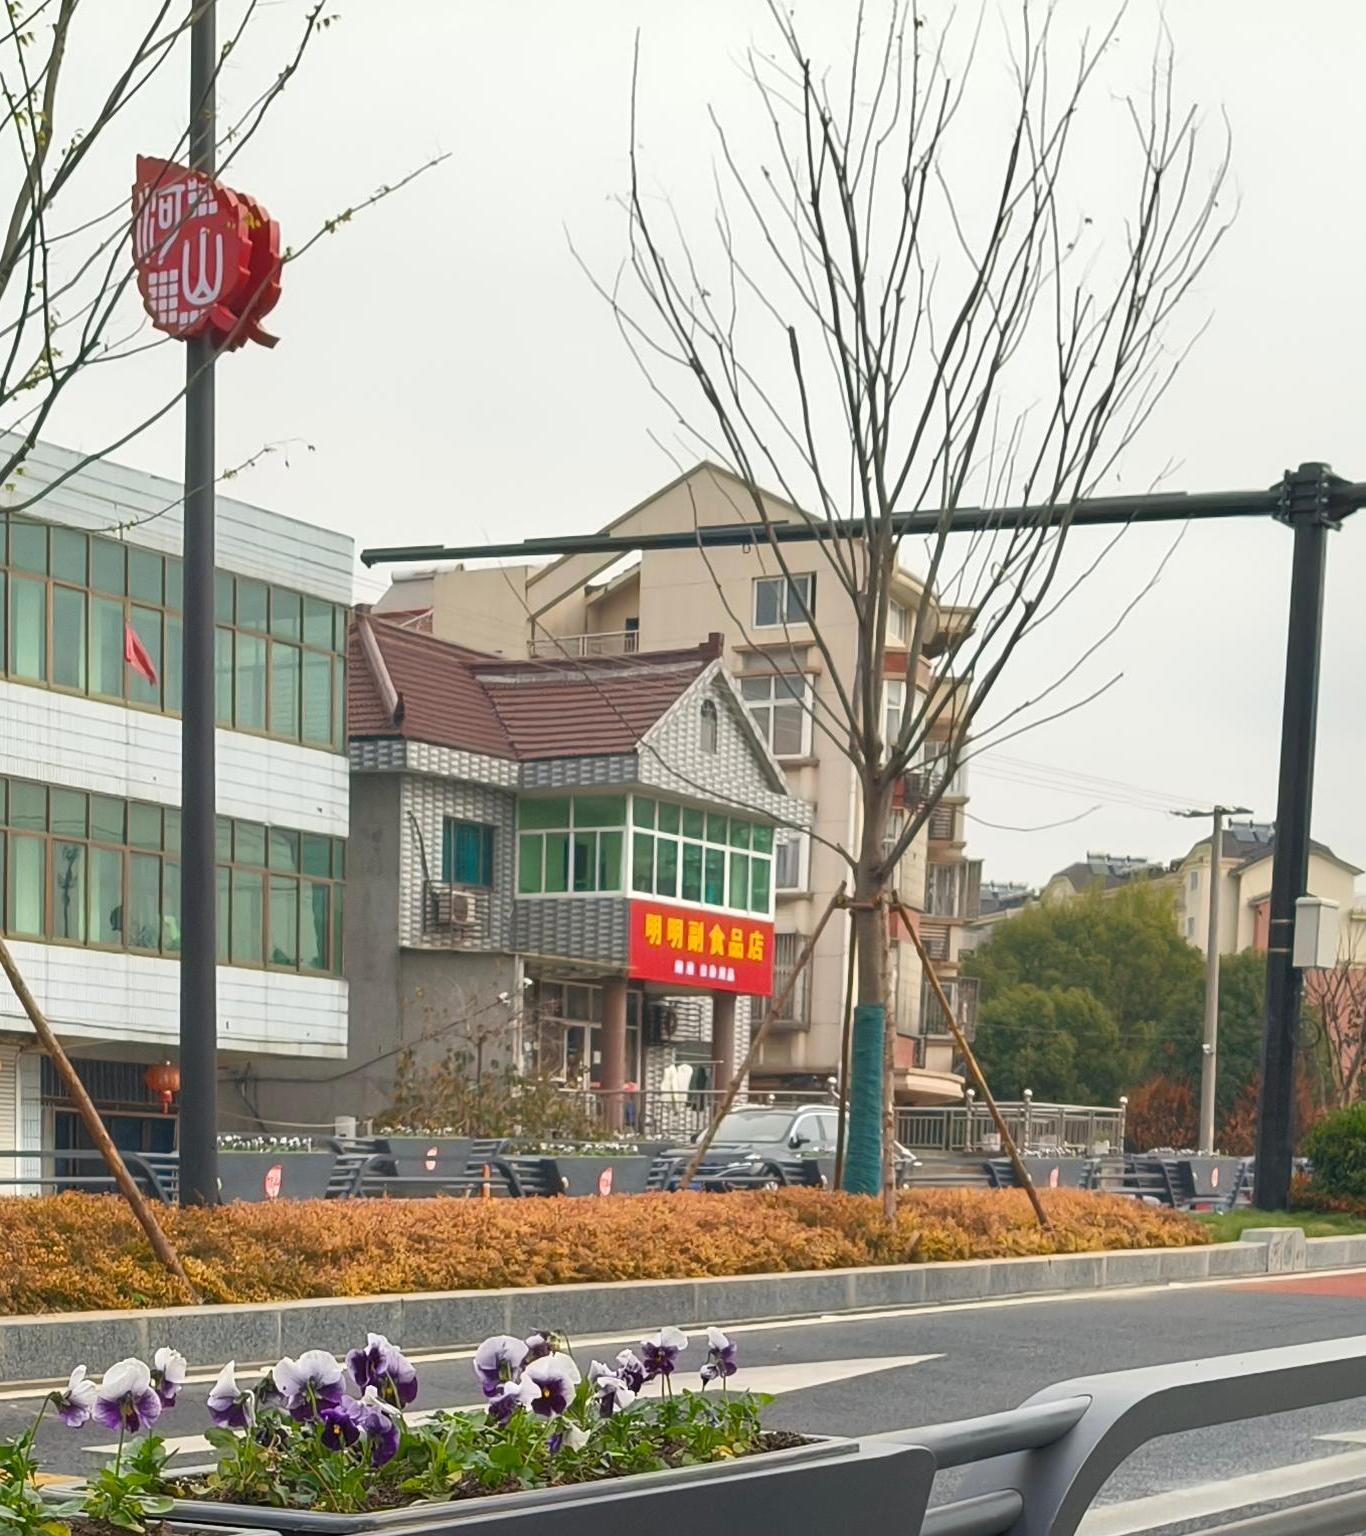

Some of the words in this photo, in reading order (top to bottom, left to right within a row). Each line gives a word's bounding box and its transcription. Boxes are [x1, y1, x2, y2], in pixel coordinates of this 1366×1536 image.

[645, 913, 764, 961] 明明副食品店
